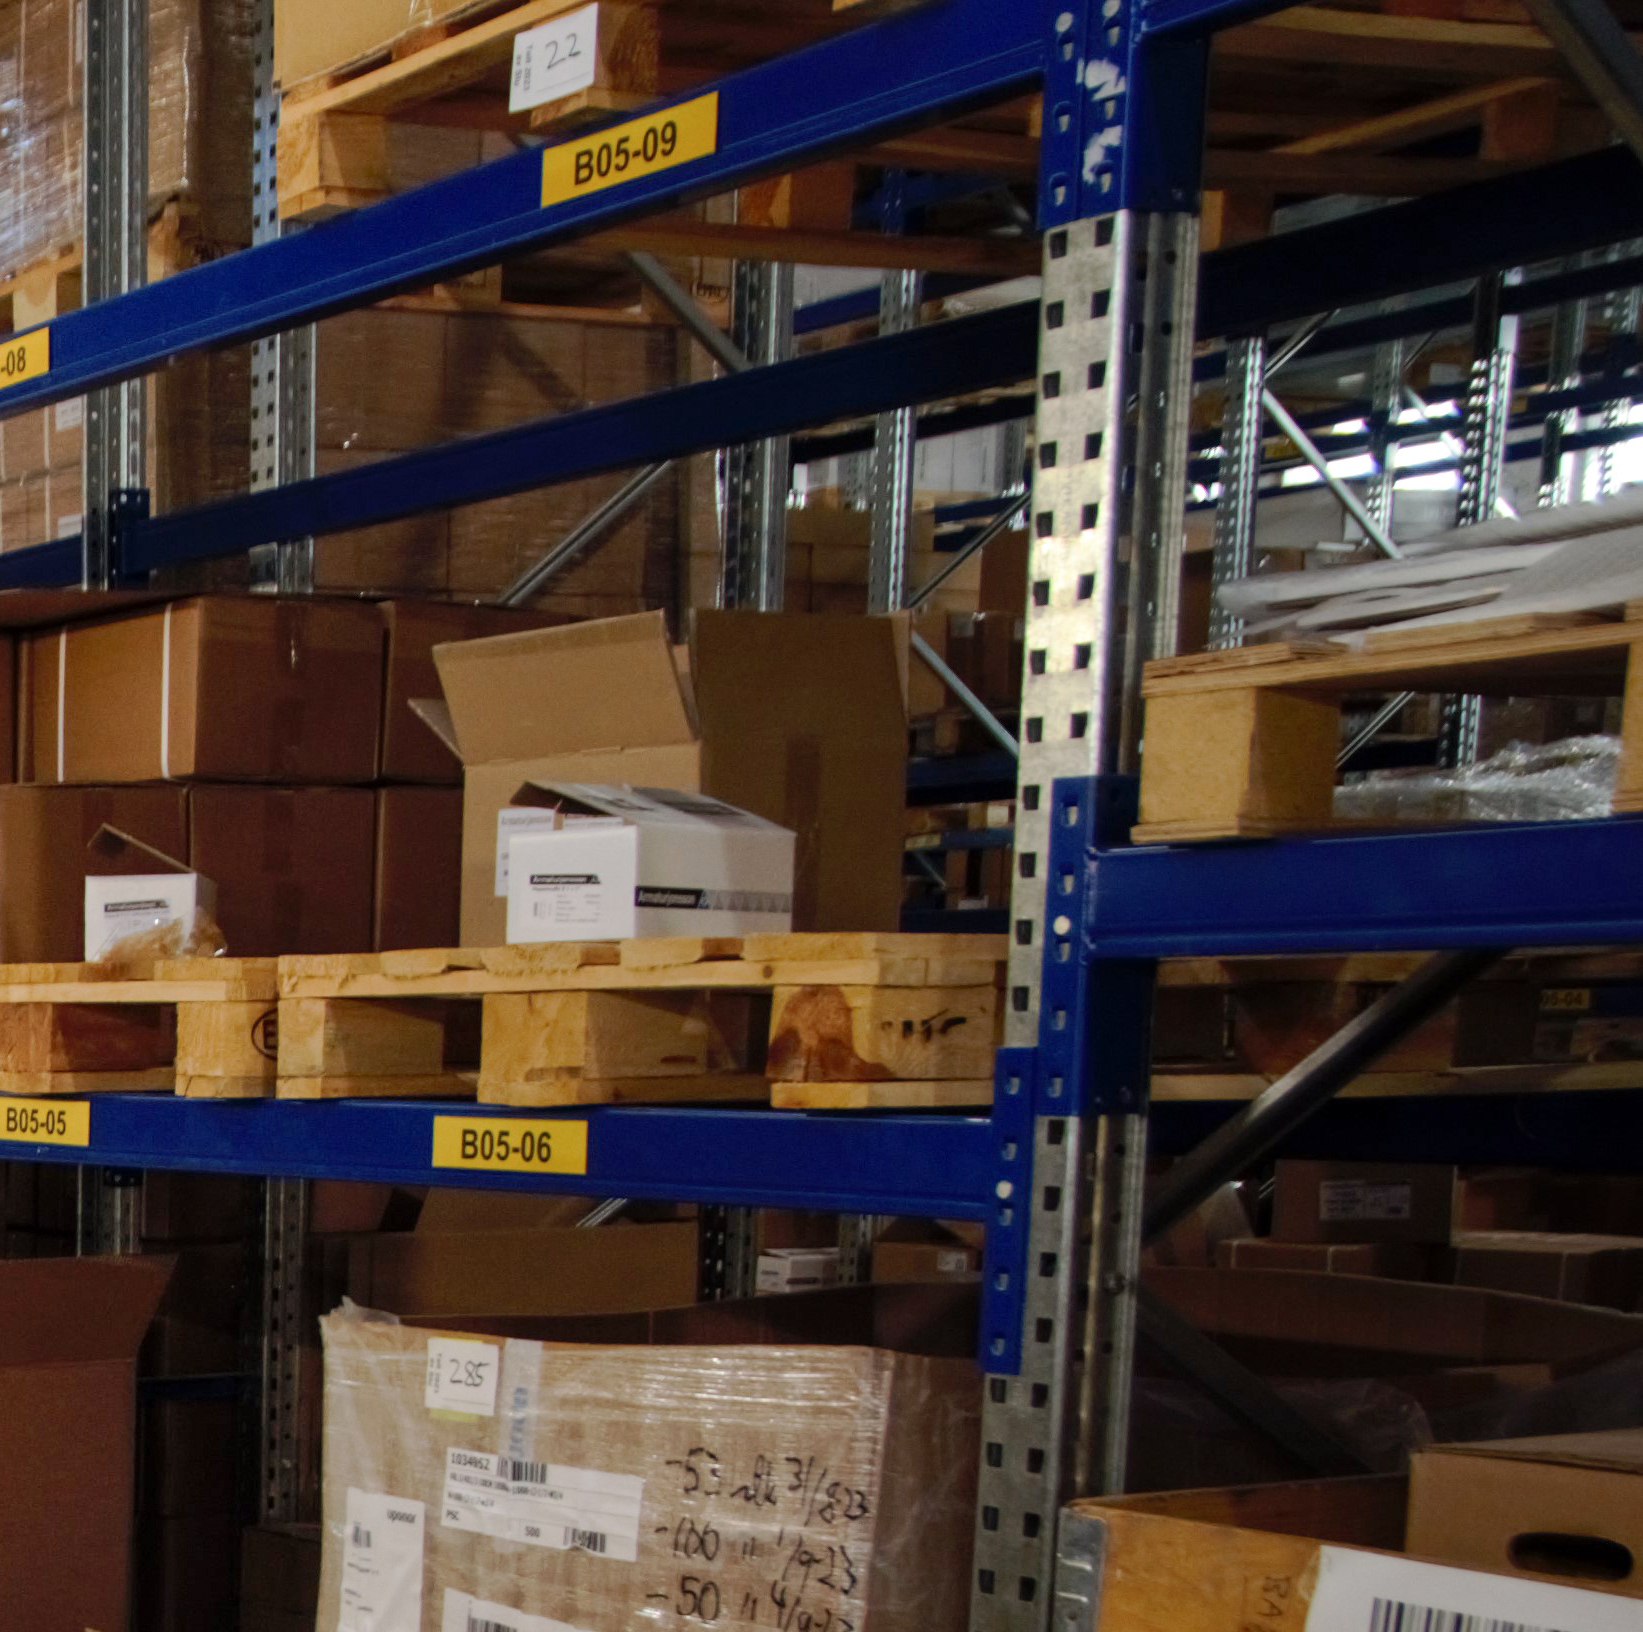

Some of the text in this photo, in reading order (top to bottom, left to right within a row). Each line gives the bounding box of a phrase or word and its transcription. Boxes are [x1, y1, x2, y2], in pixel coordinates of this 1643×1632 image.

[546, 33, 581, 70] 22
[574, 120, 677, 185] B05-09
[5, 1107, 67, 1136] B05-05
[461, 1128, 552, 1163] B05-06
[449, 1358, 489, 1388] 285
